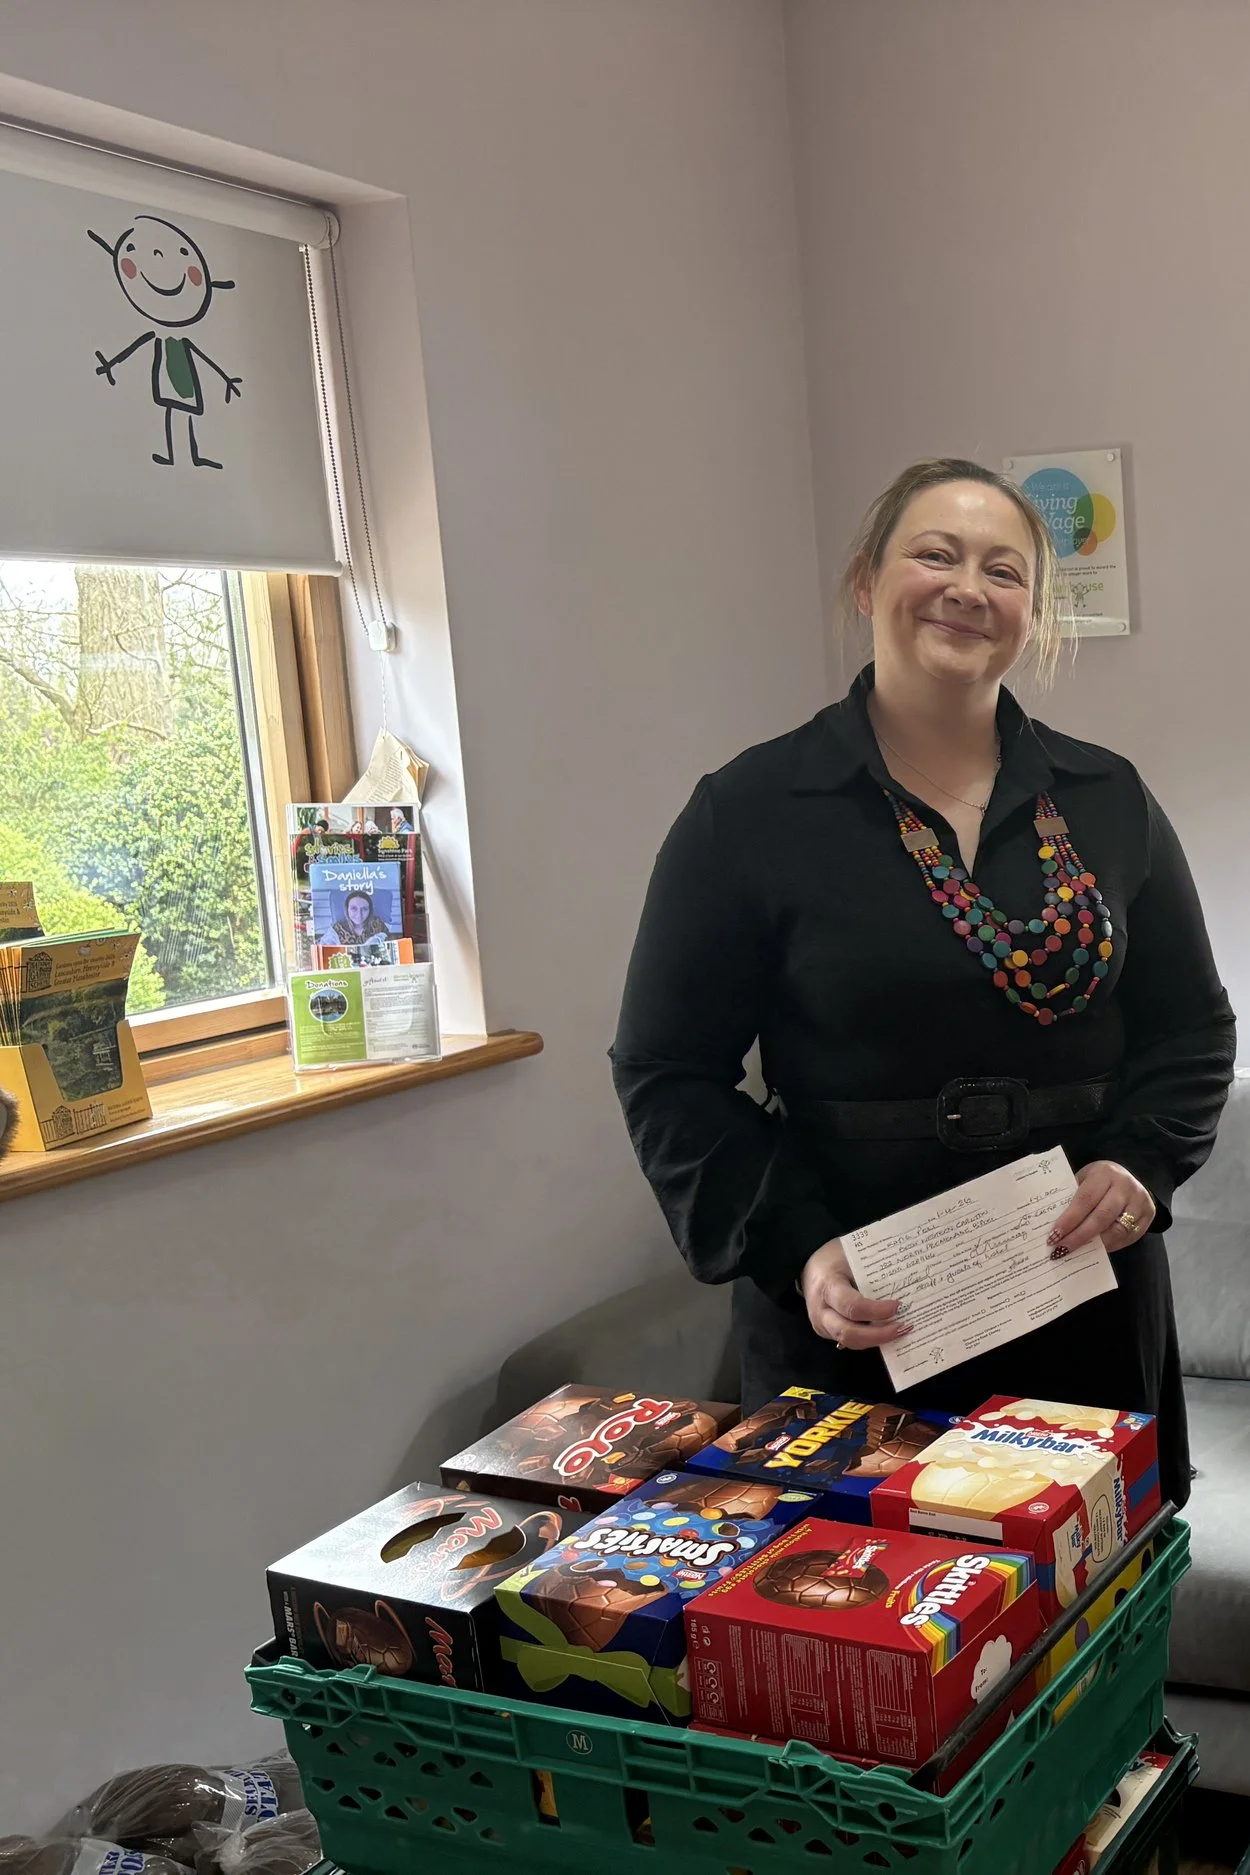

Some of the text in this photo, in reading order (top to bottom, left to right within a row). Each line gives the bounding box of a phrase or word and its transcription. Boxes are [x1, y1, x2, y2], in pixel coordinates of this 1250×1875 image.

[1029, 494, 1078, 514] iving
[321, 866, 387, 881] Daniella's
[339, 880, 374, 895] story
[306, 980, 348, 989] Donations
[764, 1401, 876, 1469] YORKIE
[970, 1427, 1087, 1456] Milkybar
[1113, 1476, 1126, 1542] Milkybar
[852, 1545, 878, 1570] Skittles
[899, 1552, 991, 1629] Skittles
[690, 1618, 698, 1635] 165
[288, 1637, 299, 1658] BAR
[424, 1616, 458, 1689] Mar
